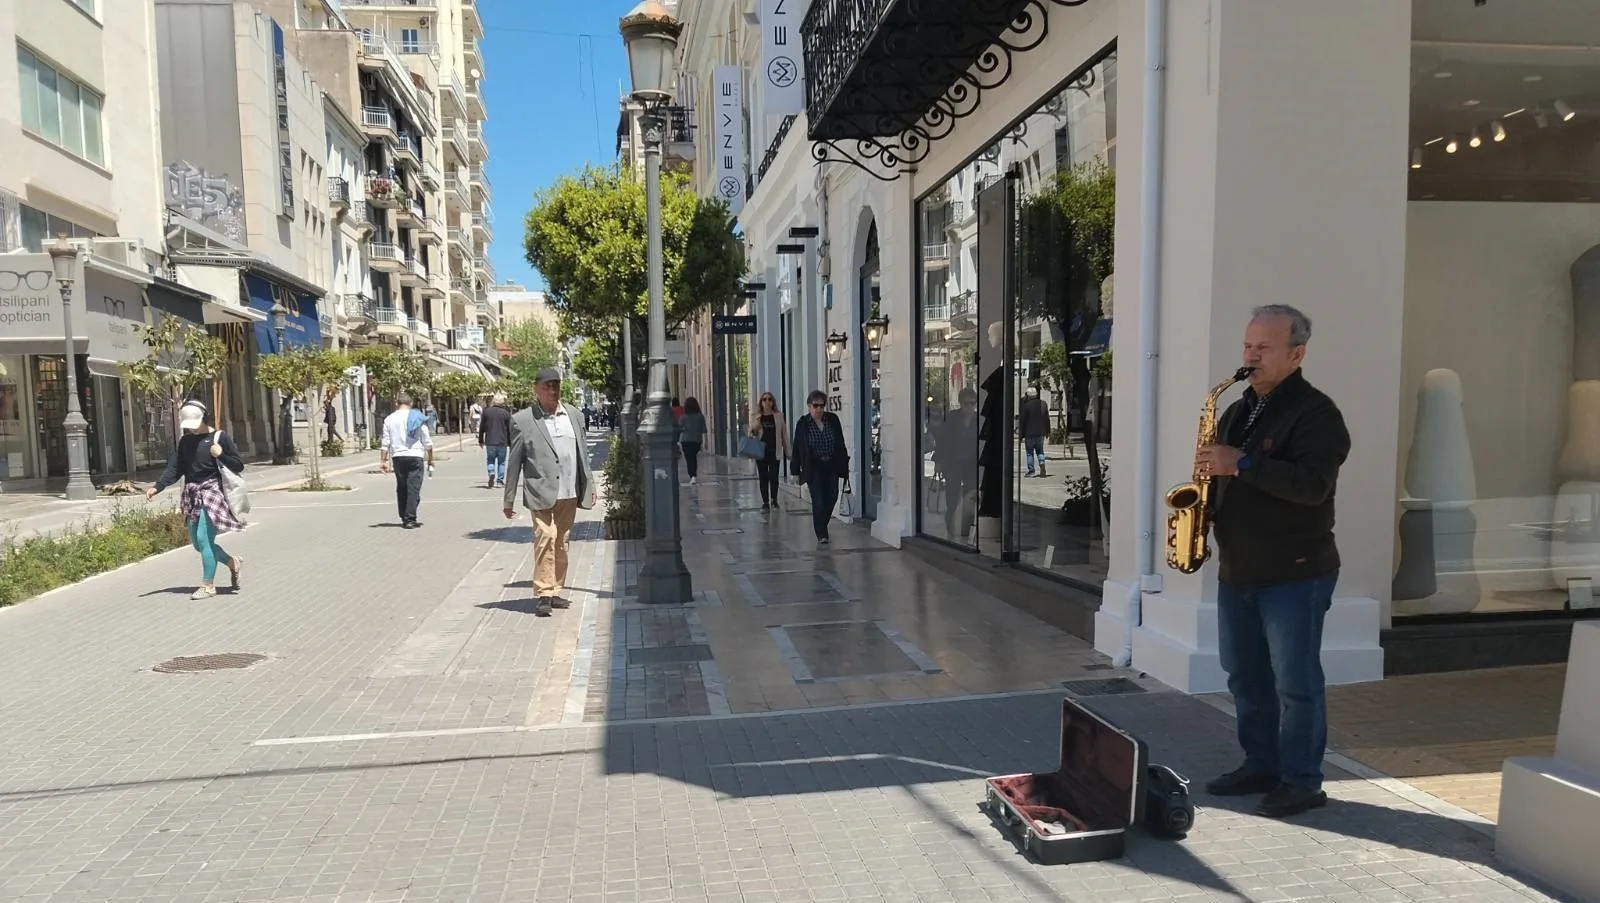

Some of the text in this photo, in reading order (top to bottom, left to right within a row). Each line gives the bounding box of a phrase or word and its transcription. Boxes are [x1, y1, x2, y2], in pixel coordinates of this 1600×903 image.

[722, 82, 733, 170] ENVIE
[0, 310, 50, 324] optician
[829, 365, 842, 383] ACC
